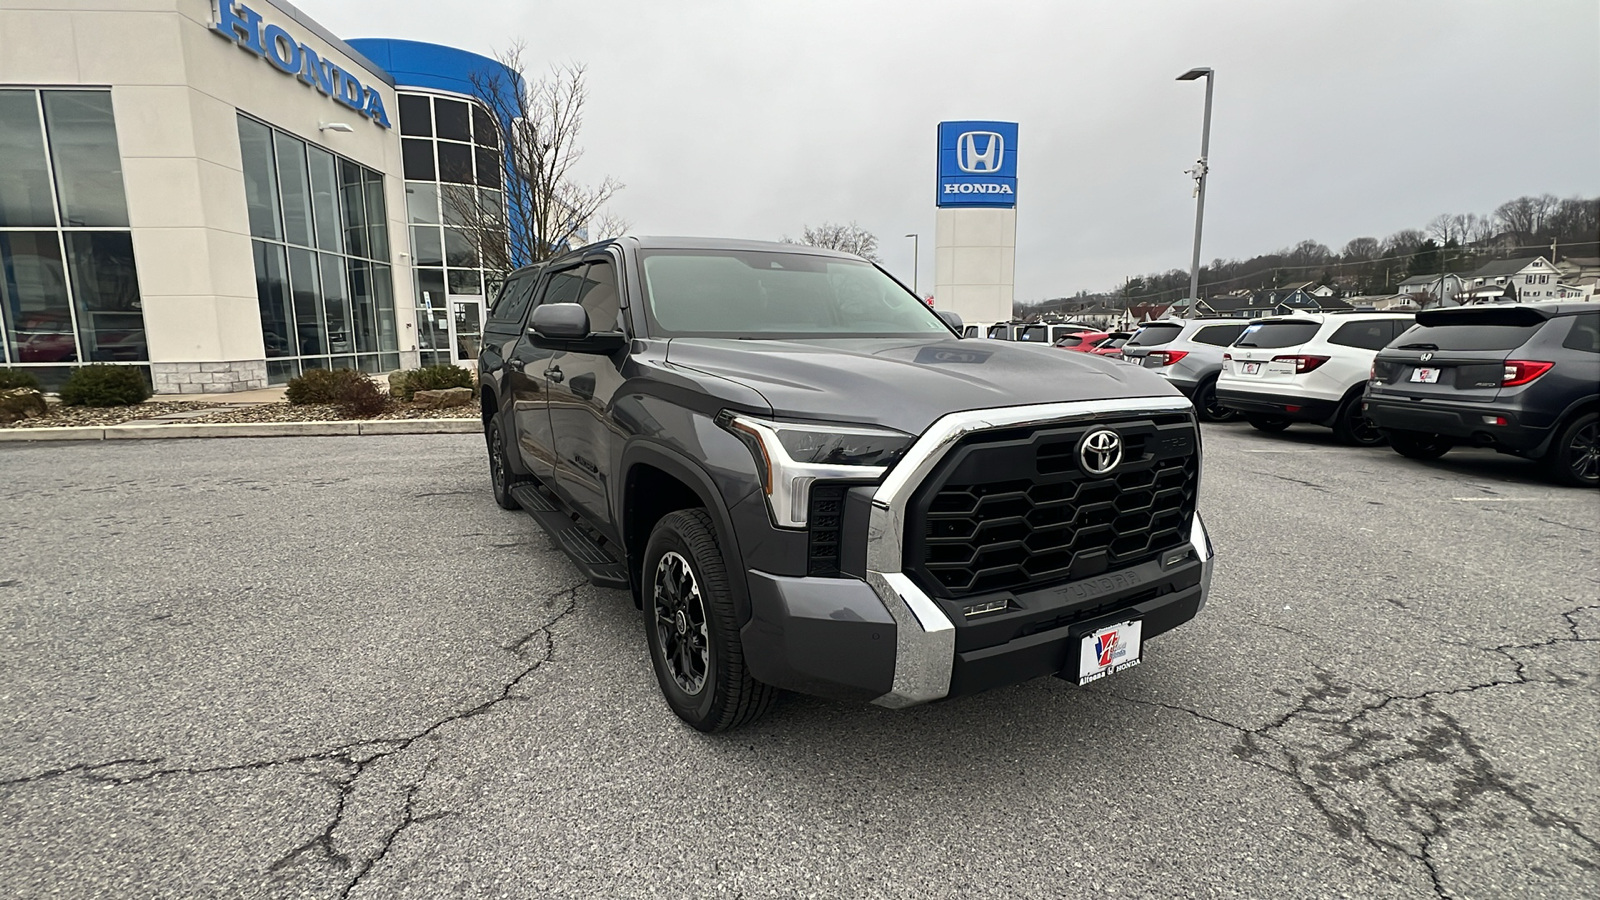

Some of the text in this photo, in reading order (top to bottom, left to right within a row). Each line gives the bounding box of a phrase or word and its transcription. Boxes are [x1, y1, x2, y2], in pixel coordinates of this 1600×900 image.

[208, 0, 391, 129] HONDA
[943, 183, 1014, 194] HONDA
[1053, 571, 1142, 602] TUNDRA
